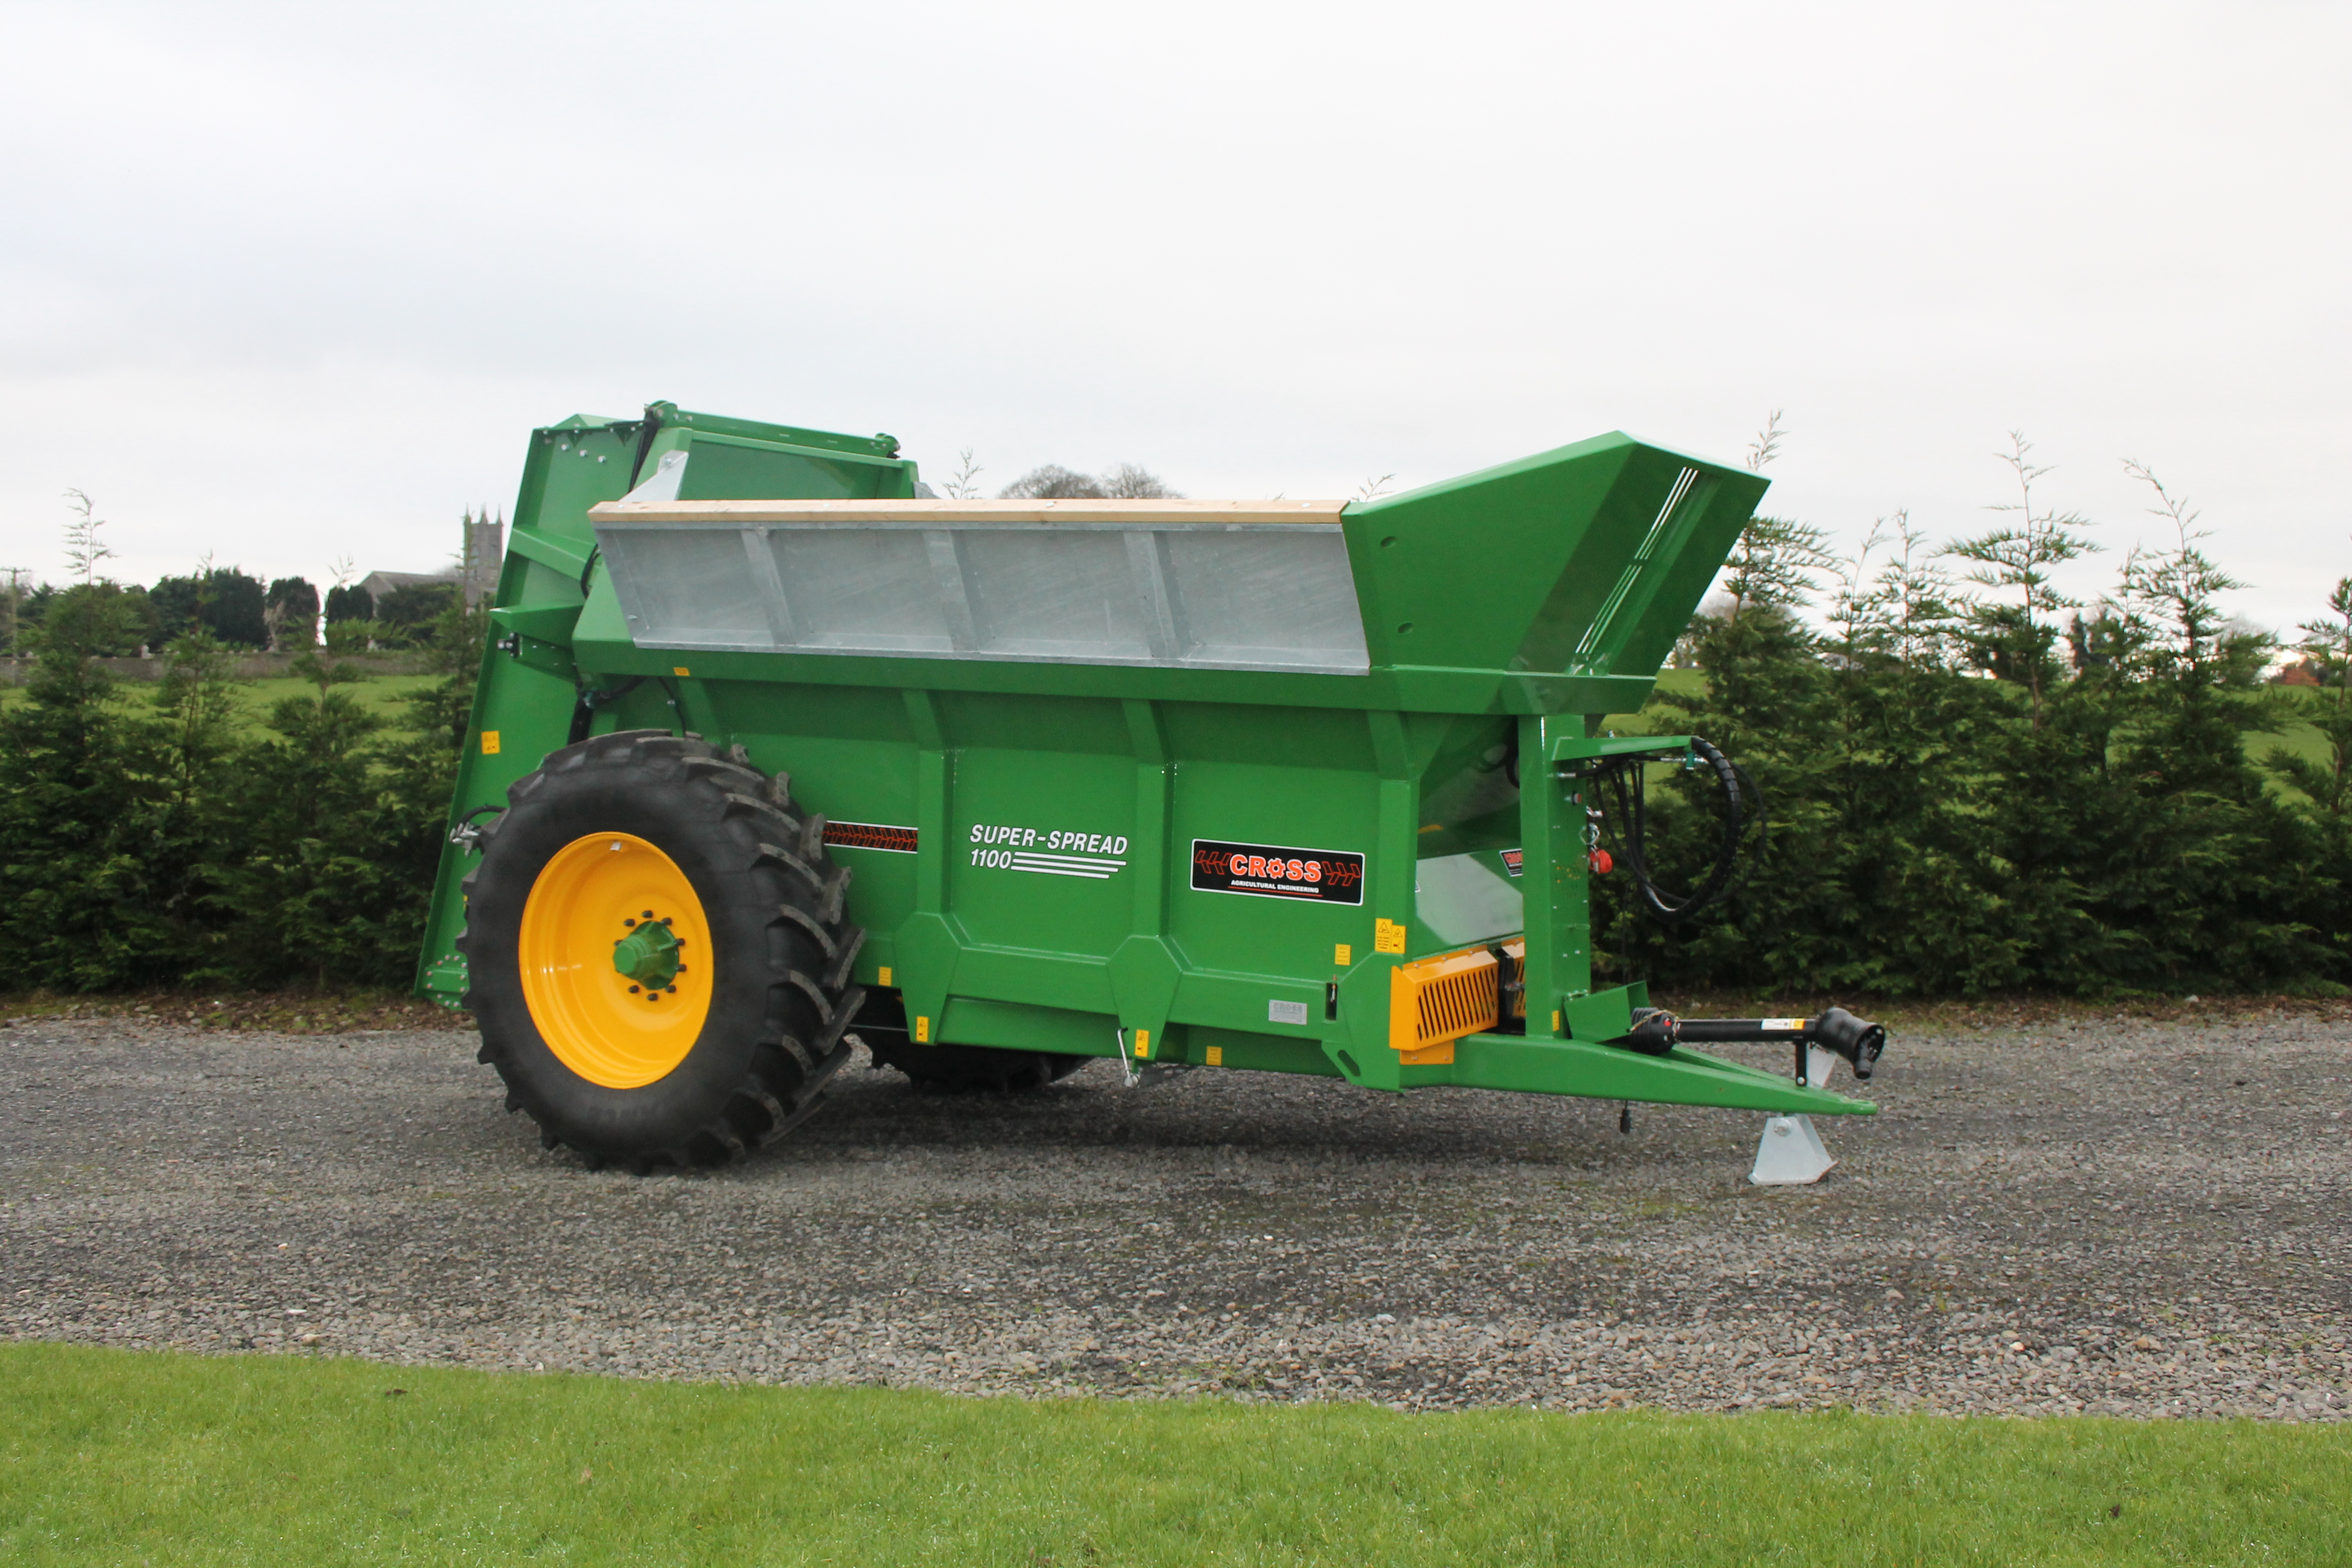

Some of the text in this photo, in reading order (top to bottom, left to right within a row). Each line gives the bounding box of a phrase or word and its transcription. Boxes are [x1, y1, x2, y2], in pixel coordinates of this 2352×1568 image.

[970, 824, 1128, 855] SUPER-SPREAD
[971, 848, 1012, 870] 1100
[1229, 854, 1321, 882] CROSS
[1231, 880, 1319, 893] AGRICULTURAL ENGINEERING
